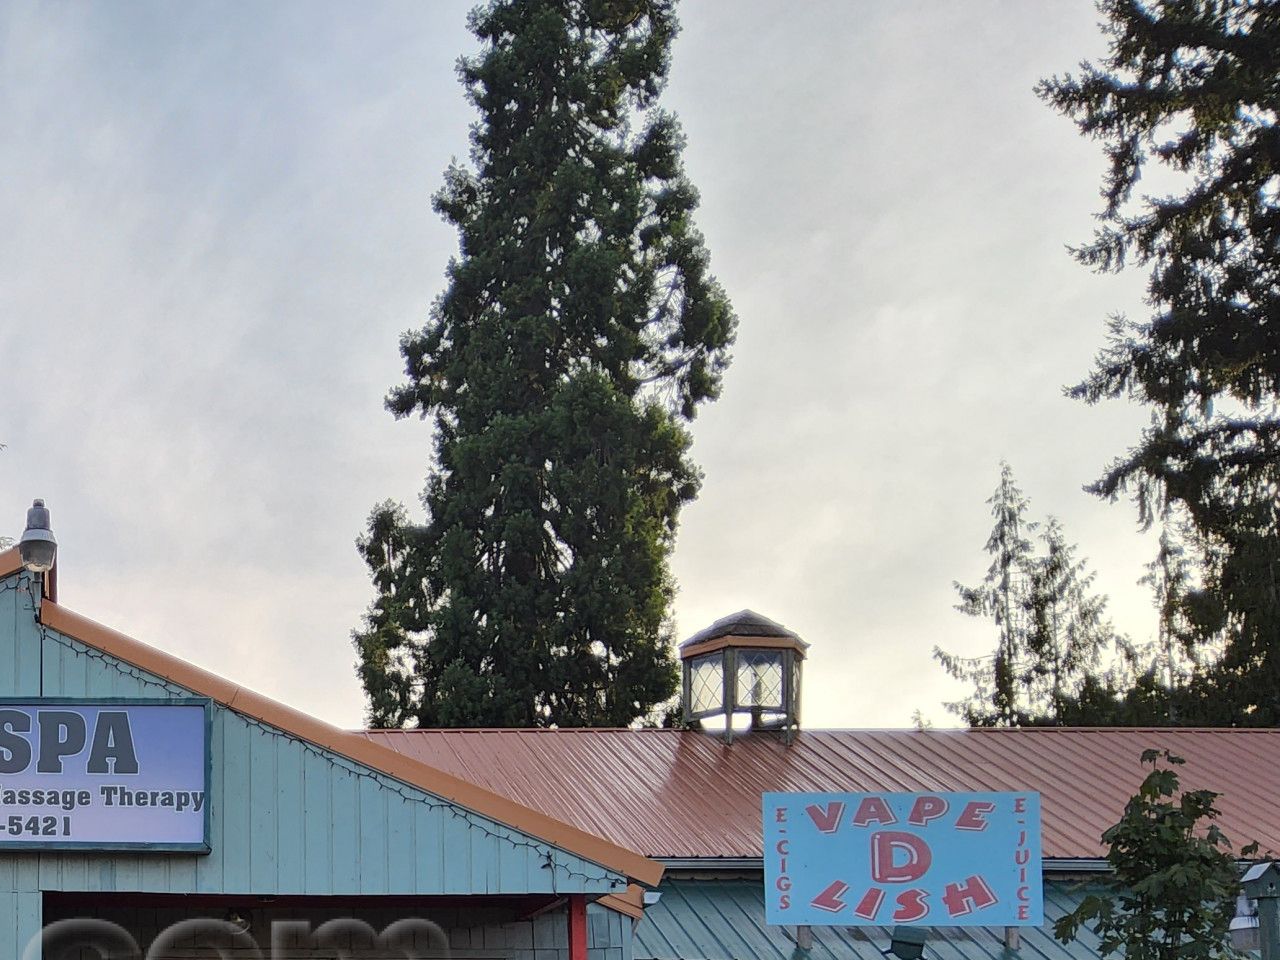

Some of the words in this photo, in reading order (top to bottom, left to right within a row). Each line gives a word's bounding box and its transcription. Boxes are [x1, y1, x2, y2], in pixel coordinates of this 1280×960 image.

[101, 785, 206, 812] Therapy
[805, 795, 996, 834] VAPE
[775, 807, 793, 910] E-CIGS
[870, 831, 932, 884] D
[1014, 798, 1031, 920] E-JUICE
[810, 875, 999, 922] LISH
